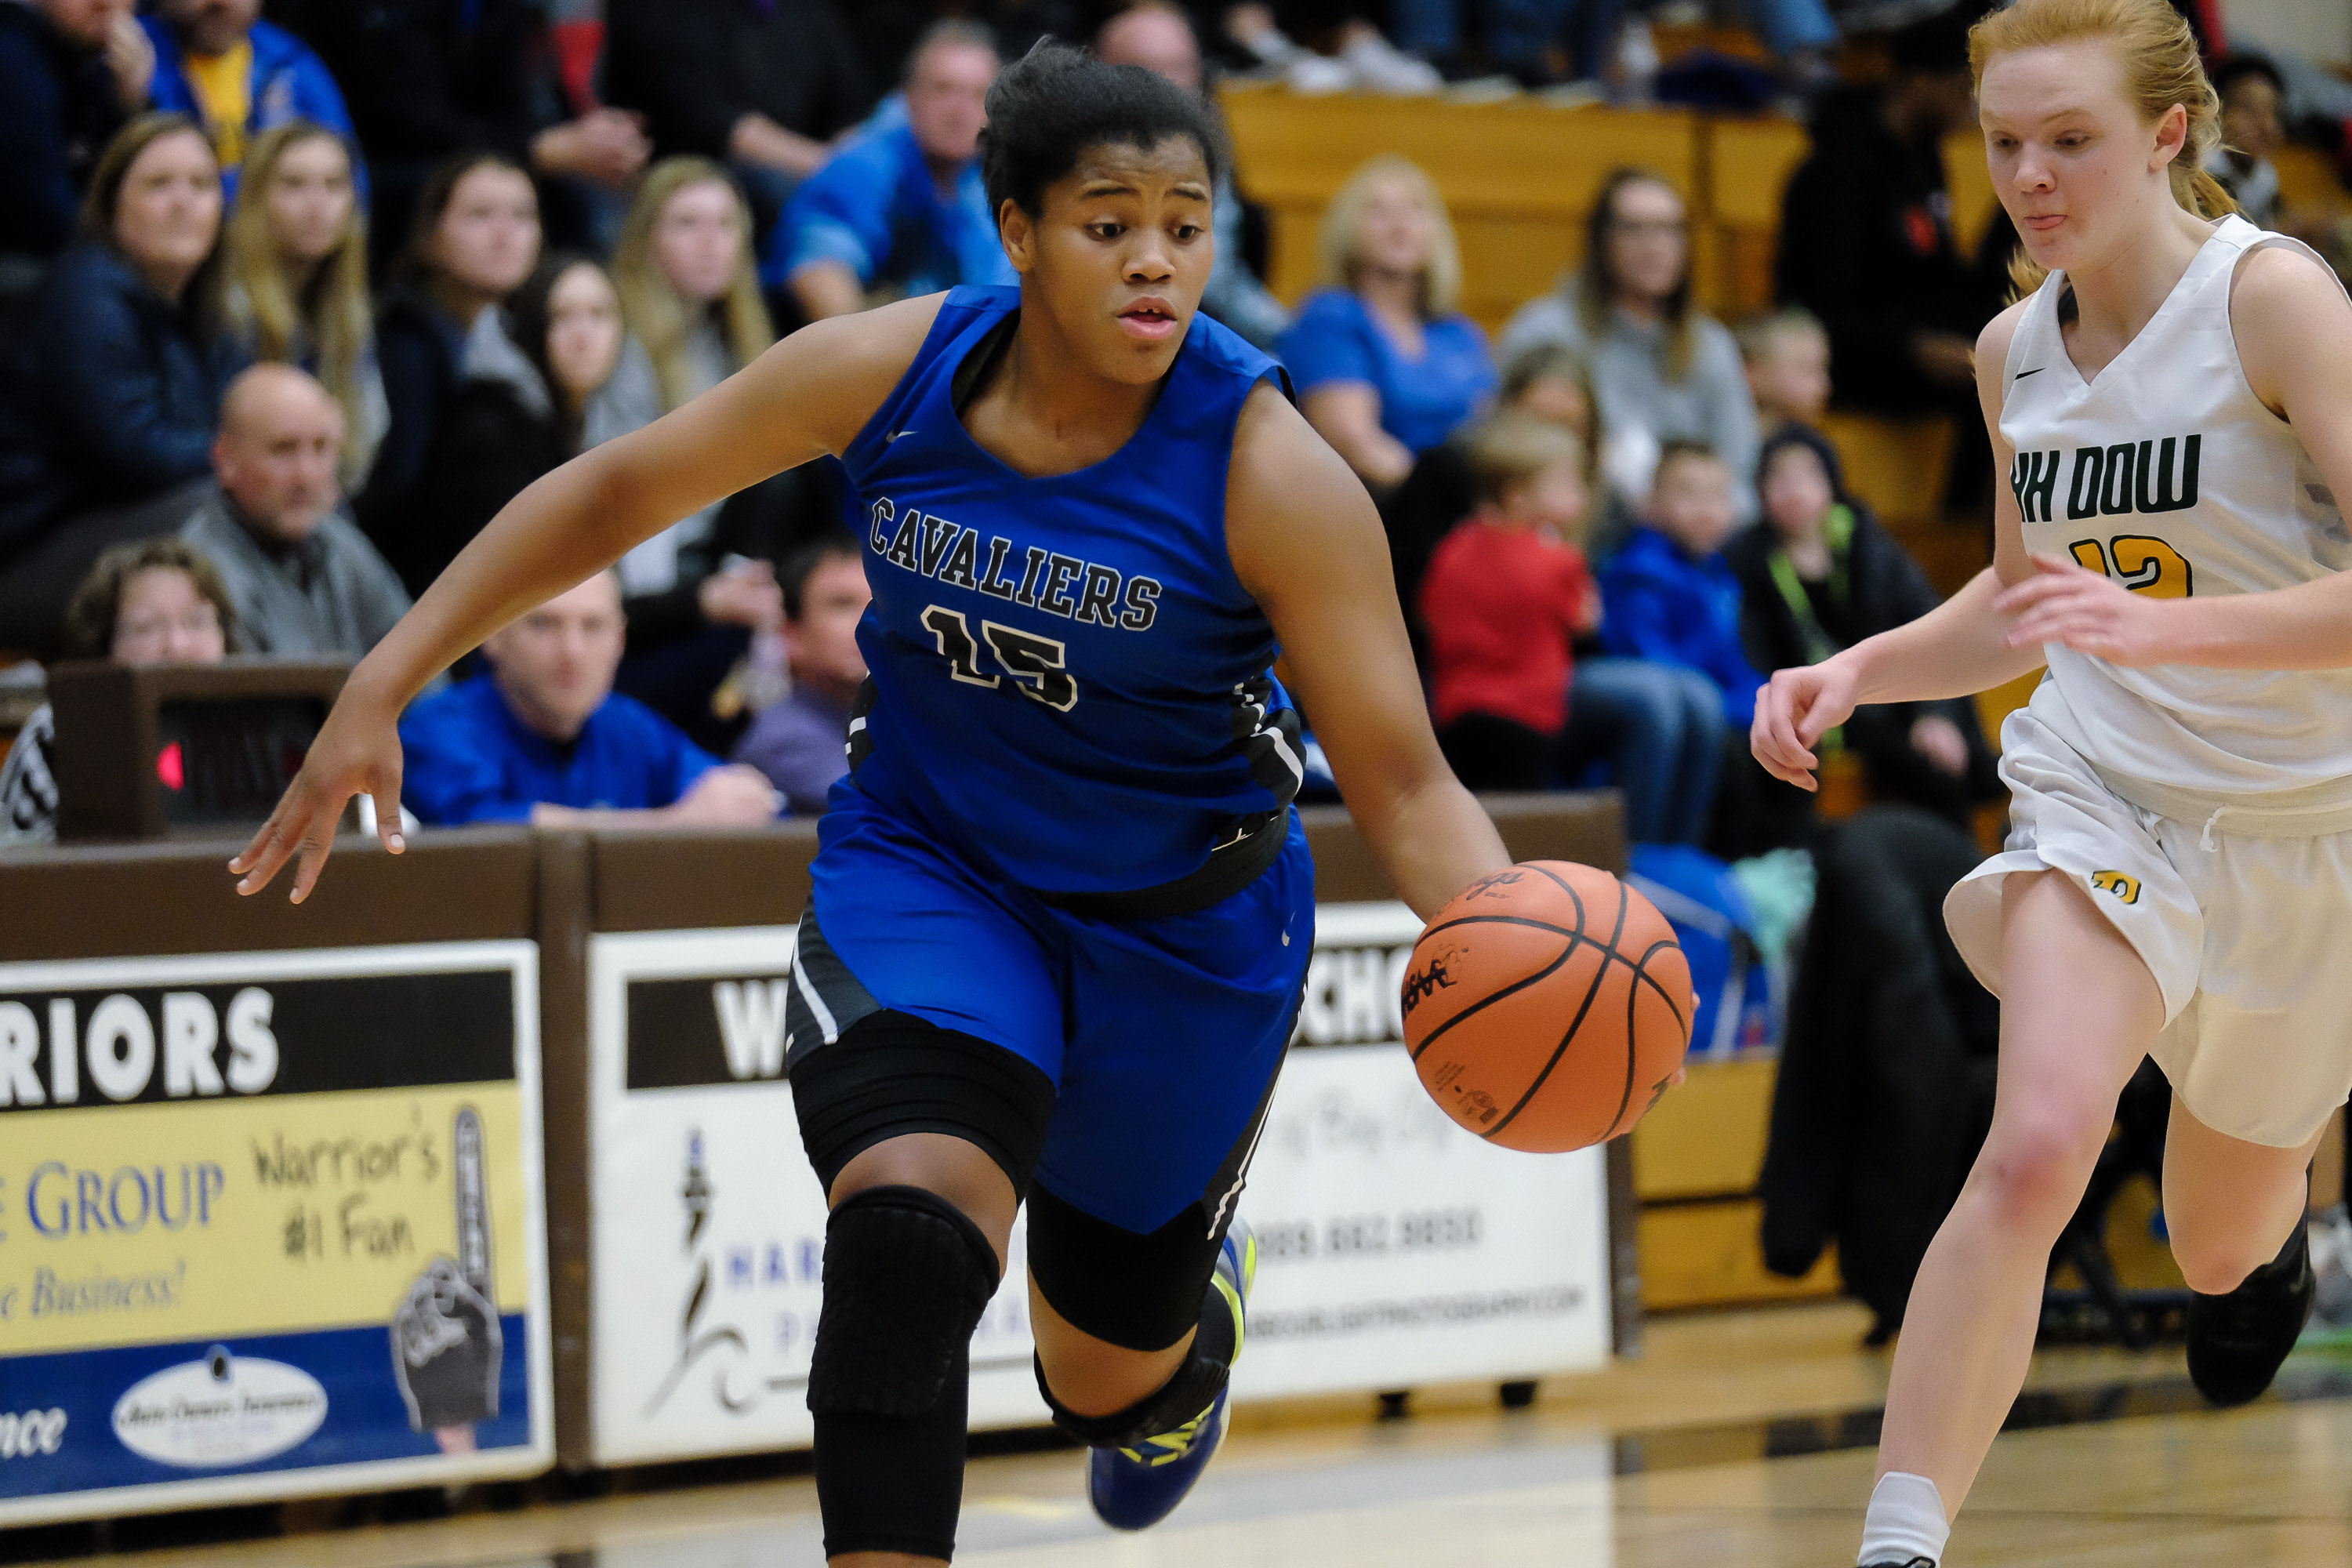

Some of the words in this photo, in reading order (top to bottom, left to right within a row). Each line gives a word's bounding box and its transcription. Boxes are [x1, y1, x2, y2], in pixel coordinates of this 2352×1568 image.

[2067, 434, 2201, 521] DOW
[870, 497, 1162, 631] CAVALIERS
[920, 604, 1077, 712] 15
[249, 1100, 441, 1186] Warrior's
[282, 1202, 323, 1261] #1
[338, 1192, 416, 1257] Fan
[31, 1257, 187, 1317] Business!
